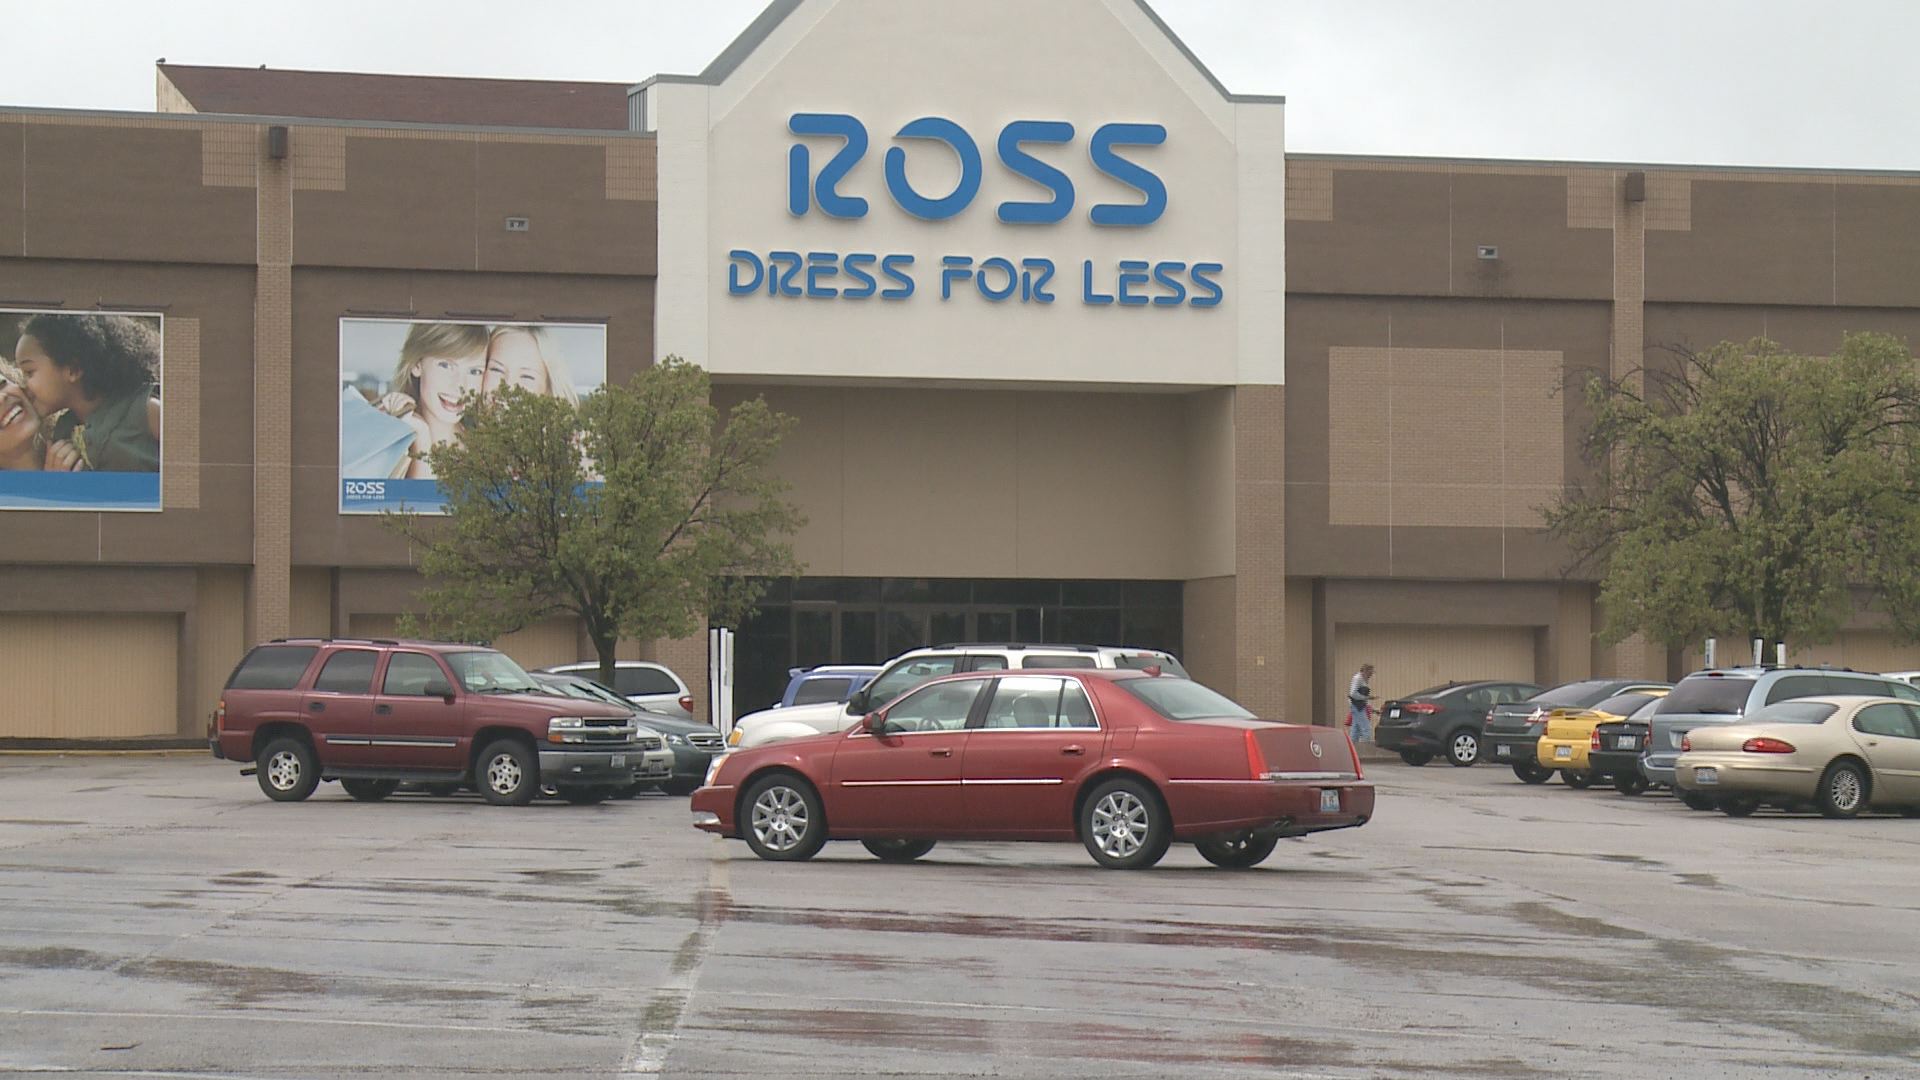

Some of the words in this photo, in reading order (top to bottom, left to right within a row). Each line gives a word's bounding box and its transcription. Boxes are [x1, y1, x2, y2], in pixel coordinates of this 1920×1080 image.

[788, 113, 1168, 226] ROSS
[728, 250, 916, 298] DRESS
[941, 256, 1055, 302] FOR
[1083, 260, 1223, 307] LESS
[346, 482, 385, 494] ROSS
